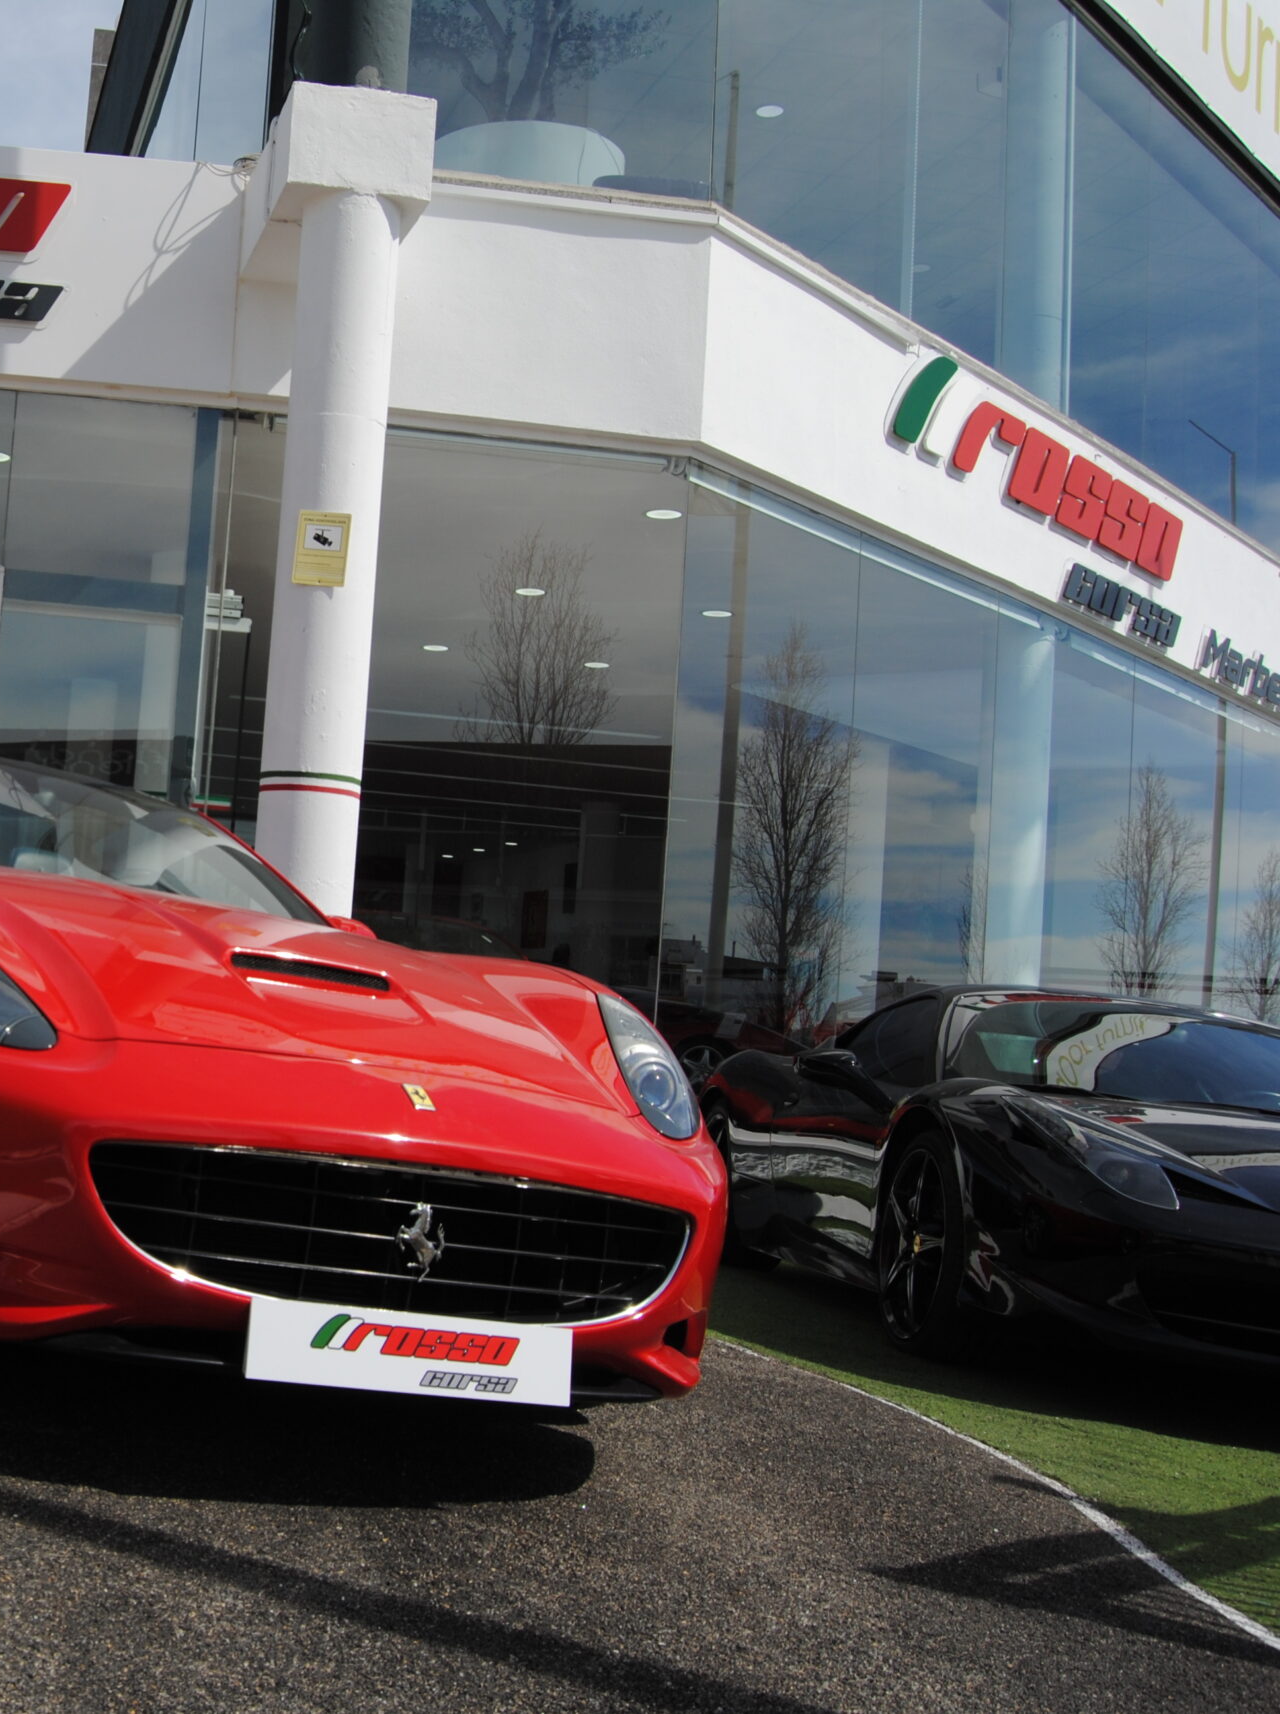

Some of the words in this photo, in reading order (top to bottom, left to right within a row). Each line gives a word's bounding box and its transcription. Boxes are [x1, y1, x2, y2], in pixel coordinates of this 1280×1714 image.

[952, 400, 1184, 582] rosso
[1062, 562, 1182, 648] corsa
[343, 1323, 520, 1366] rosso
[420, 1370, 518, 1394] corsa
